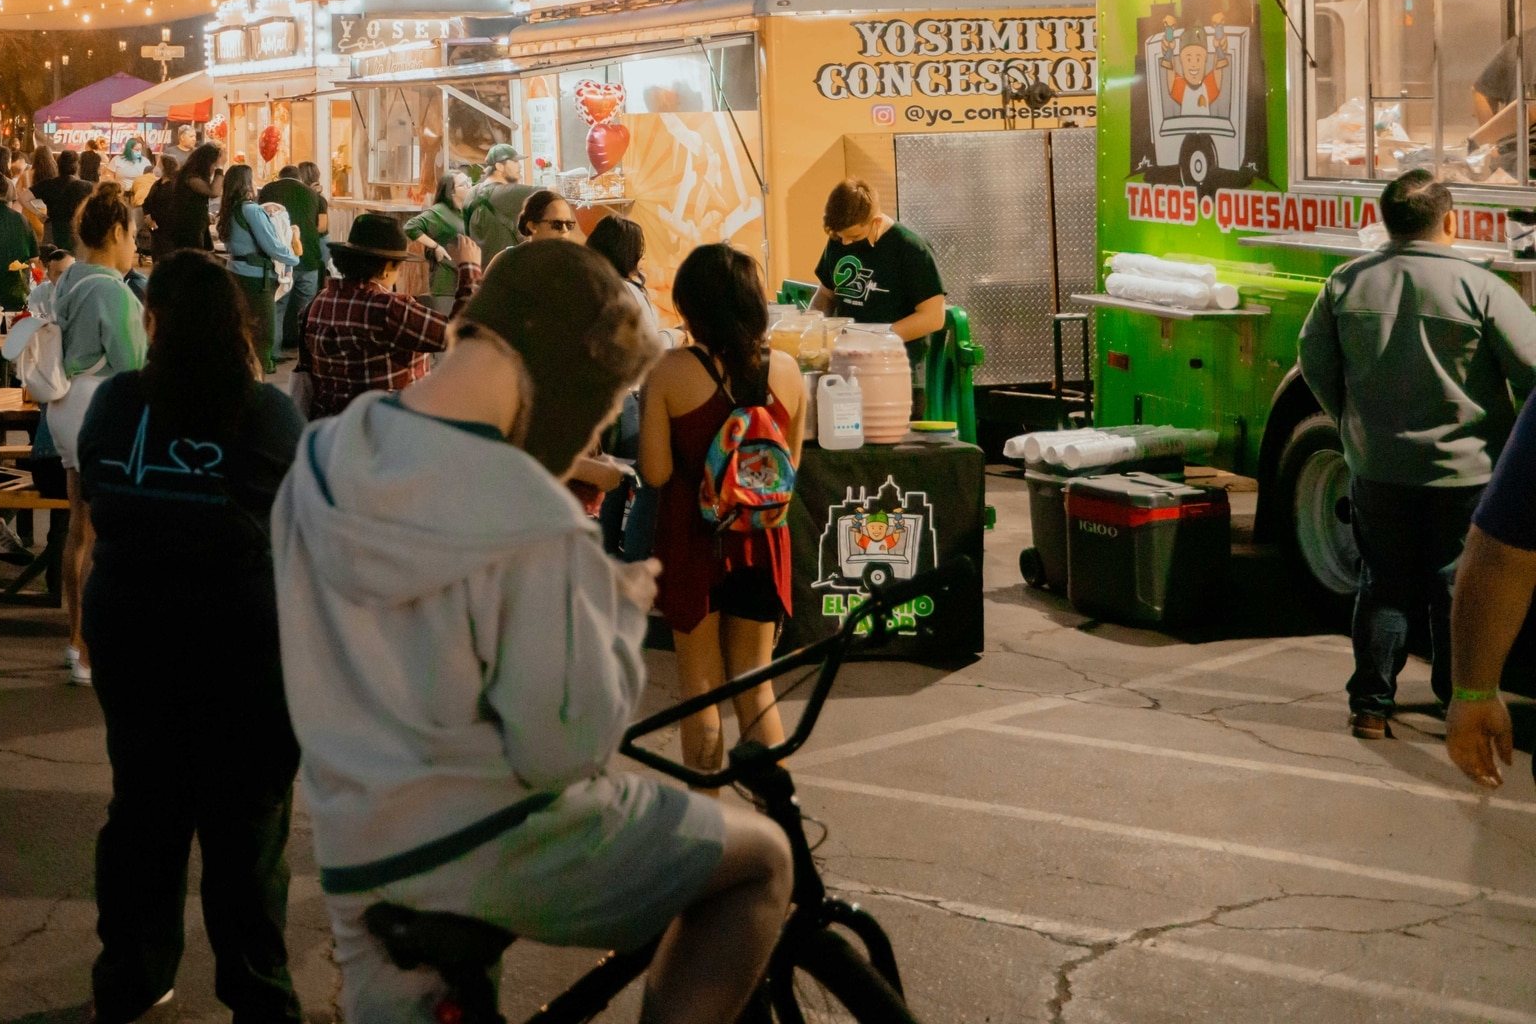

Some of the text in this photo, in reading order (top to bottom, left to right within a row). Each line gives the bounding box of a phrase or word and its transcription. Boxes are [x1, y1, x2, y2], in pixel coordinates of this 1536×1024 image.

[814, 57, 1096, 100] CONCESSIO
[1126, 183, 1382, 233] TACOS QUESADILLA
[1078, 519, 1119, 538] IGLOO
[822, 594, 846, 616] EL
